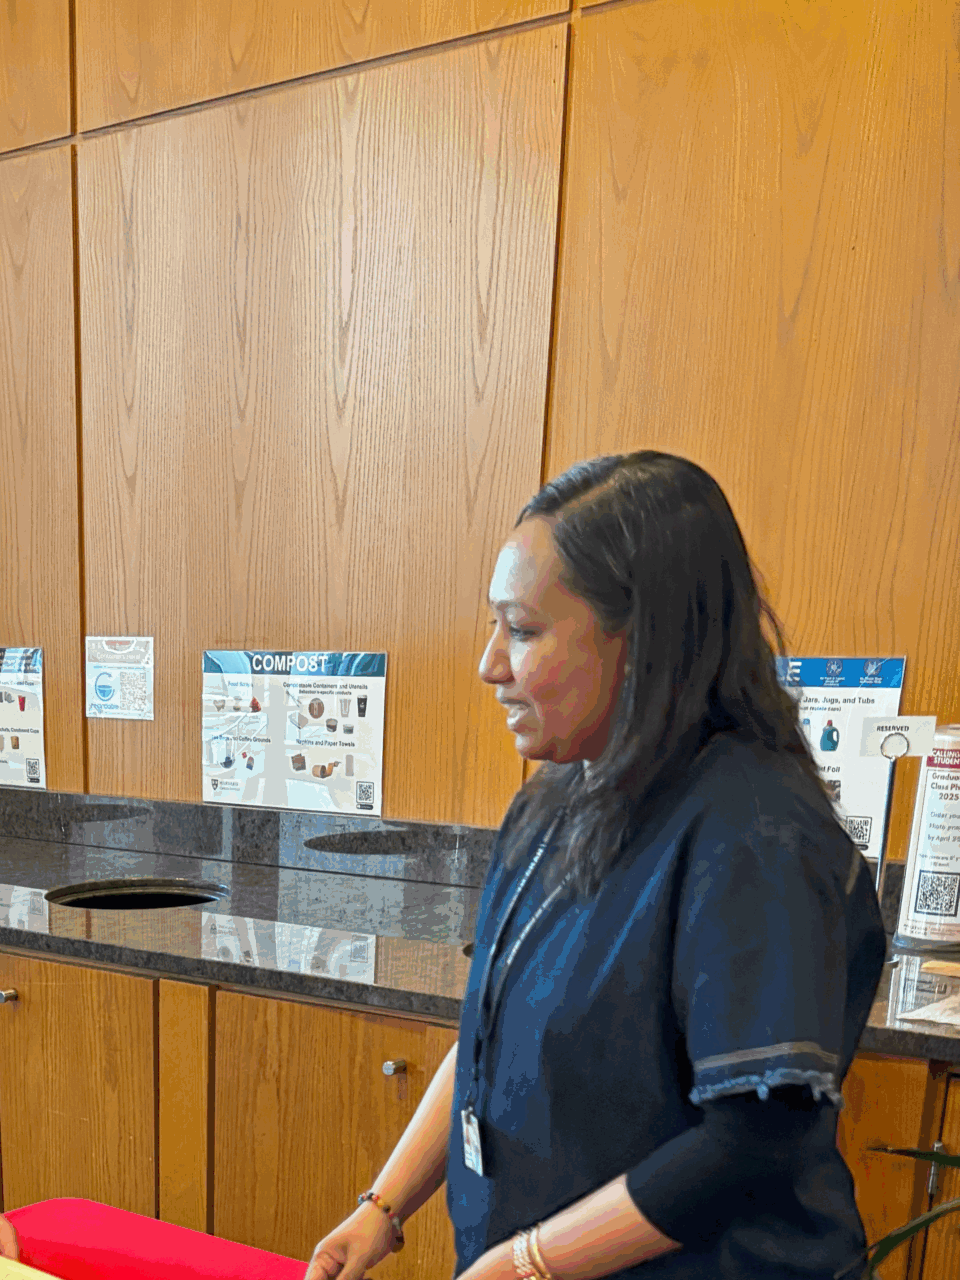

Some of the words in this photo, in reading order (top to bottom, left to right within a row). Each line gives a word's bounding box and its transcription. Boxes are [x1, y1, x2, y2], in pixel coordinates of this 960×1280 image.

[252, 655, 328, 672] COMPOST
[312, 682, 338, 690] Containers
[930, 783, 949, 791] Class
[939, 792, 959, 801] 2025
